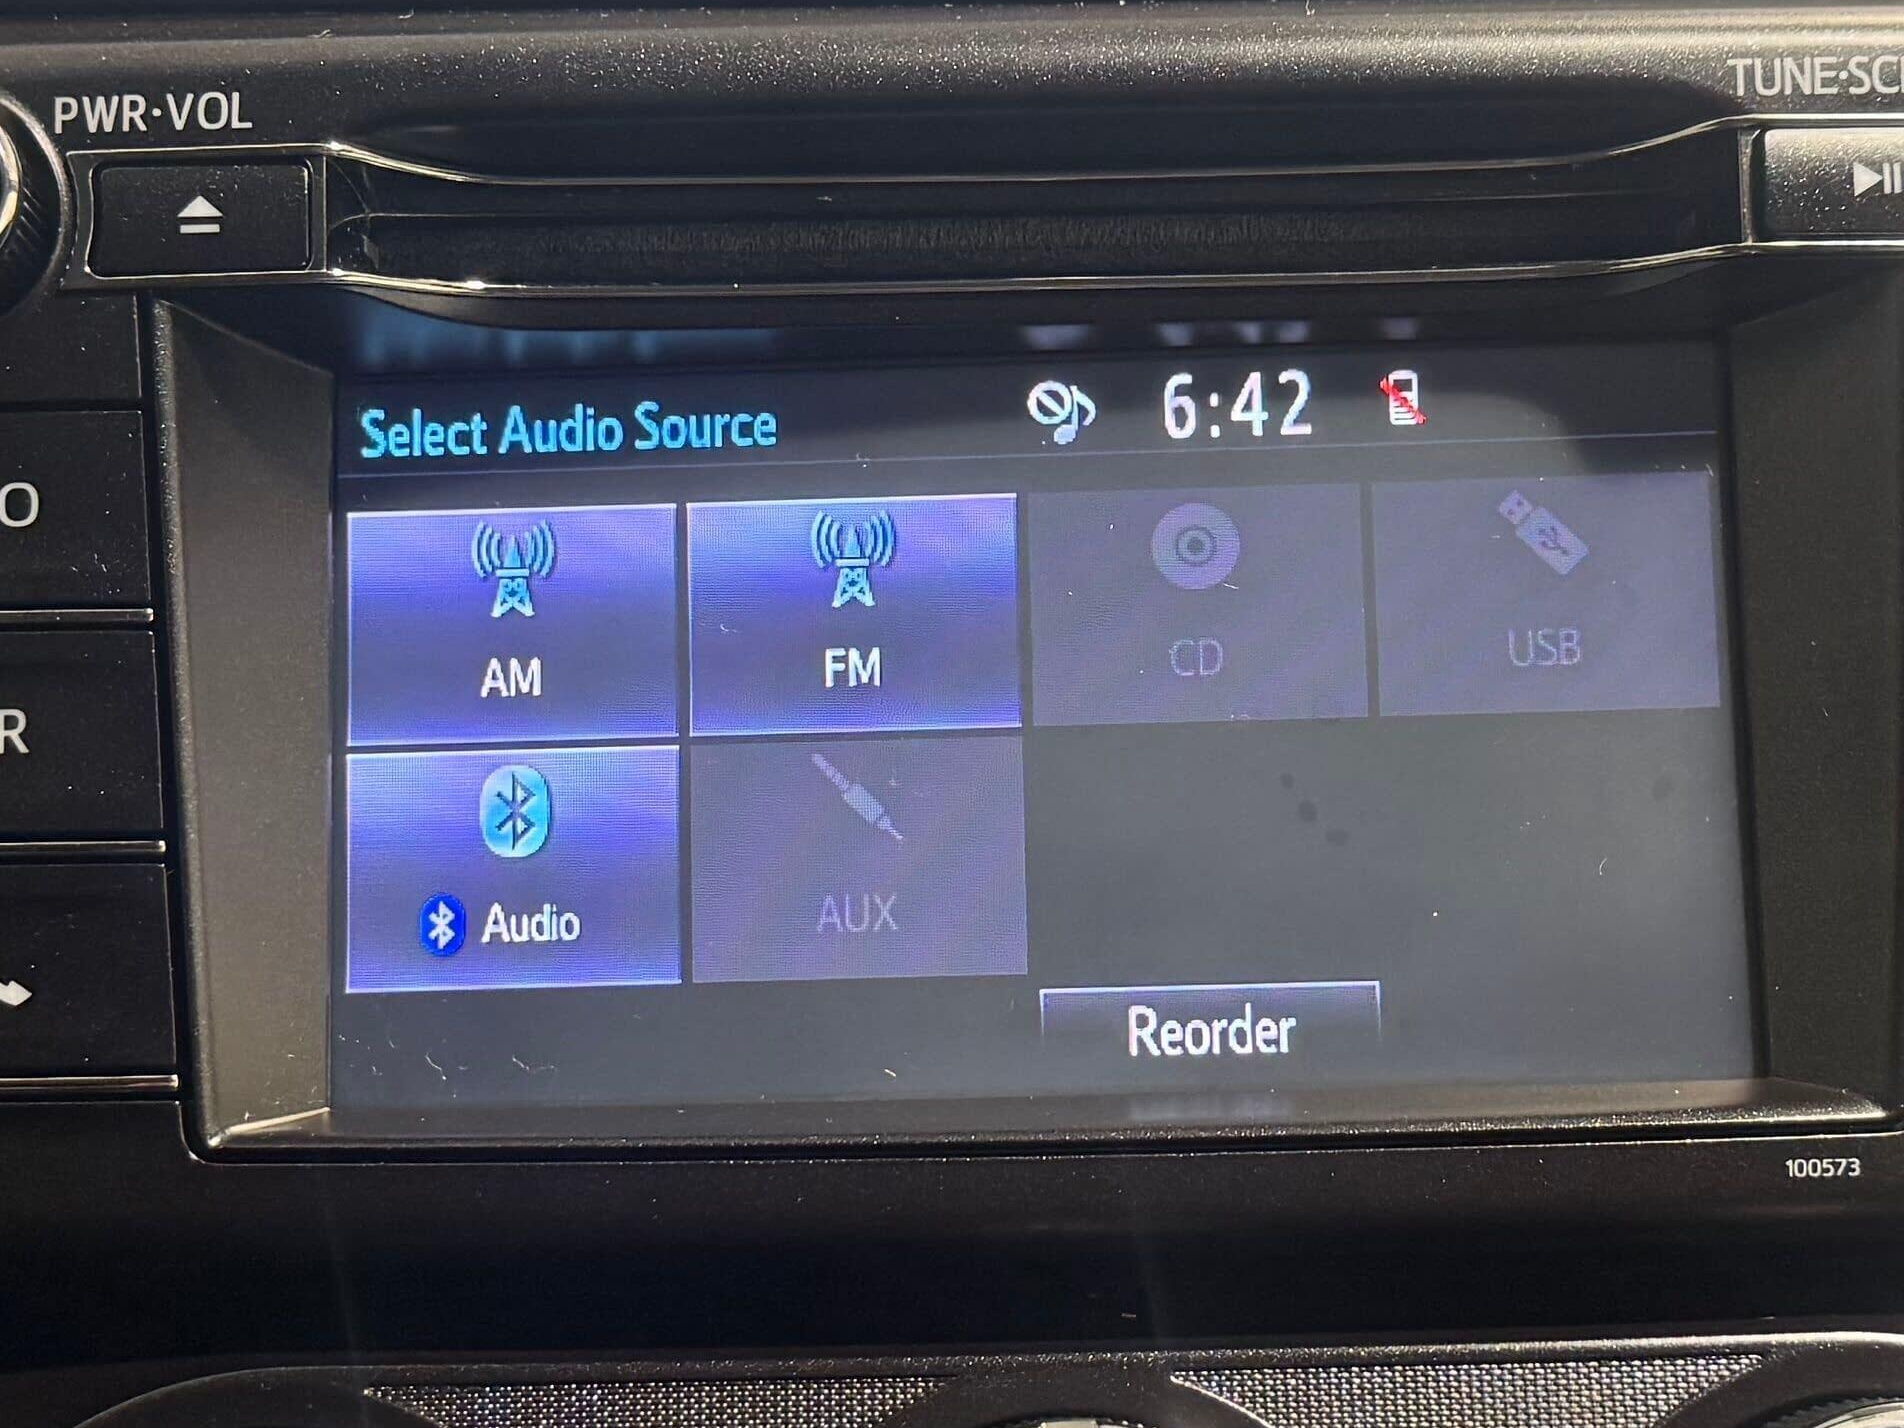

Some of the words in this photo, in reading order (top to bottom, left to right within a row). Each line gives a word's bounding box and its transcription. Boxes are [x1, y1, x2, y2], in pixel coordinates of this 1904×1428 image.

[1164, 370, 1312, 439] 6:42
[361, 409, 487, 458] Select
[499, 404, 623, 453] Audio
[635, 401, 776, 449] Source
[1169, 639, 1223, 676] CD
[1508, 629, 1580, 666] USB
[481, 658, 540, 697] AM
[826, 648, 880, 687] FM
[481, 903, 579, 943] Audio
[817, 894, 897, 932] AUX
[1128, 1006, 1296, 1056] Reorder
[1786, 1158, 1860, 1177] 100573
